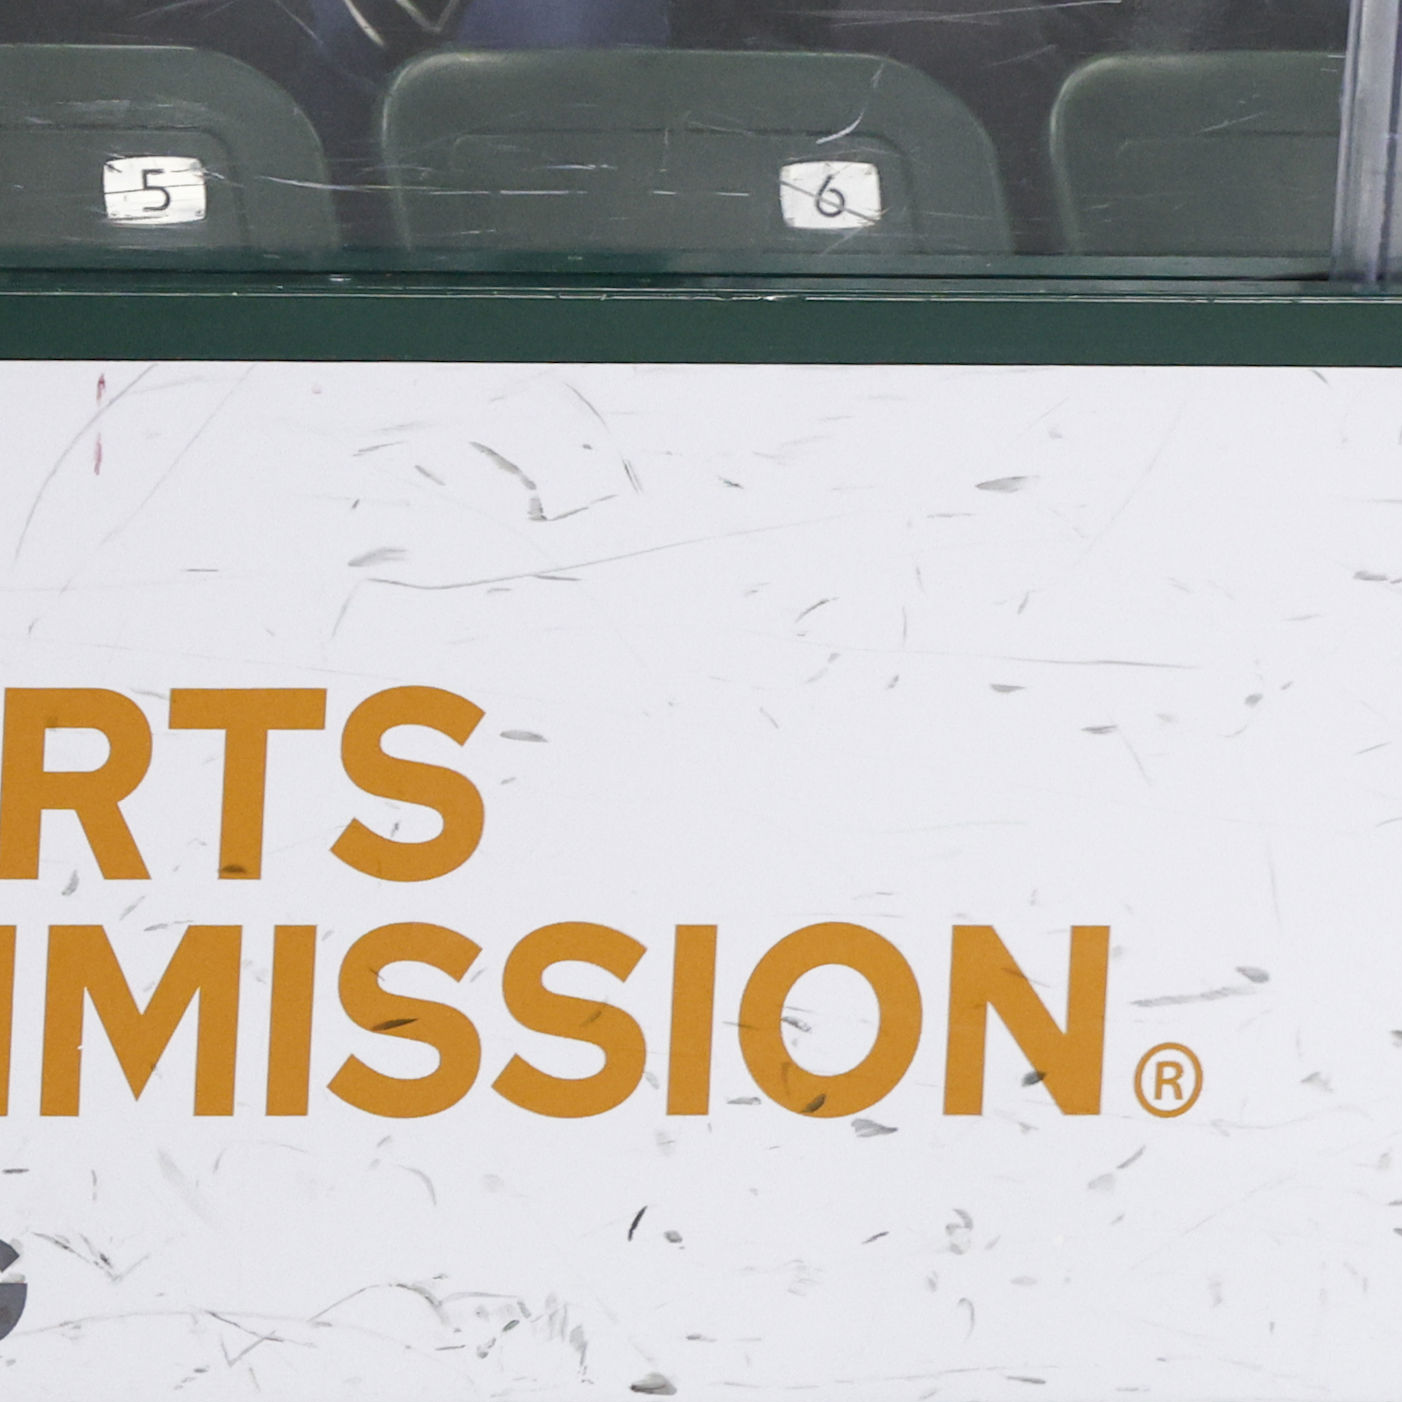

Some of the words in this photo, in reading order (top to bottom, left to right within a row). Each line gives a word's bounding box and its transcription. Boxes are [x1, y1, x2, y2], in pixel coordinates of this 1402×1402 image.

[140, 168, 172, 212] 5
[814, 173, 847, 218] 6
[0, 685, 487, 882] RTS
